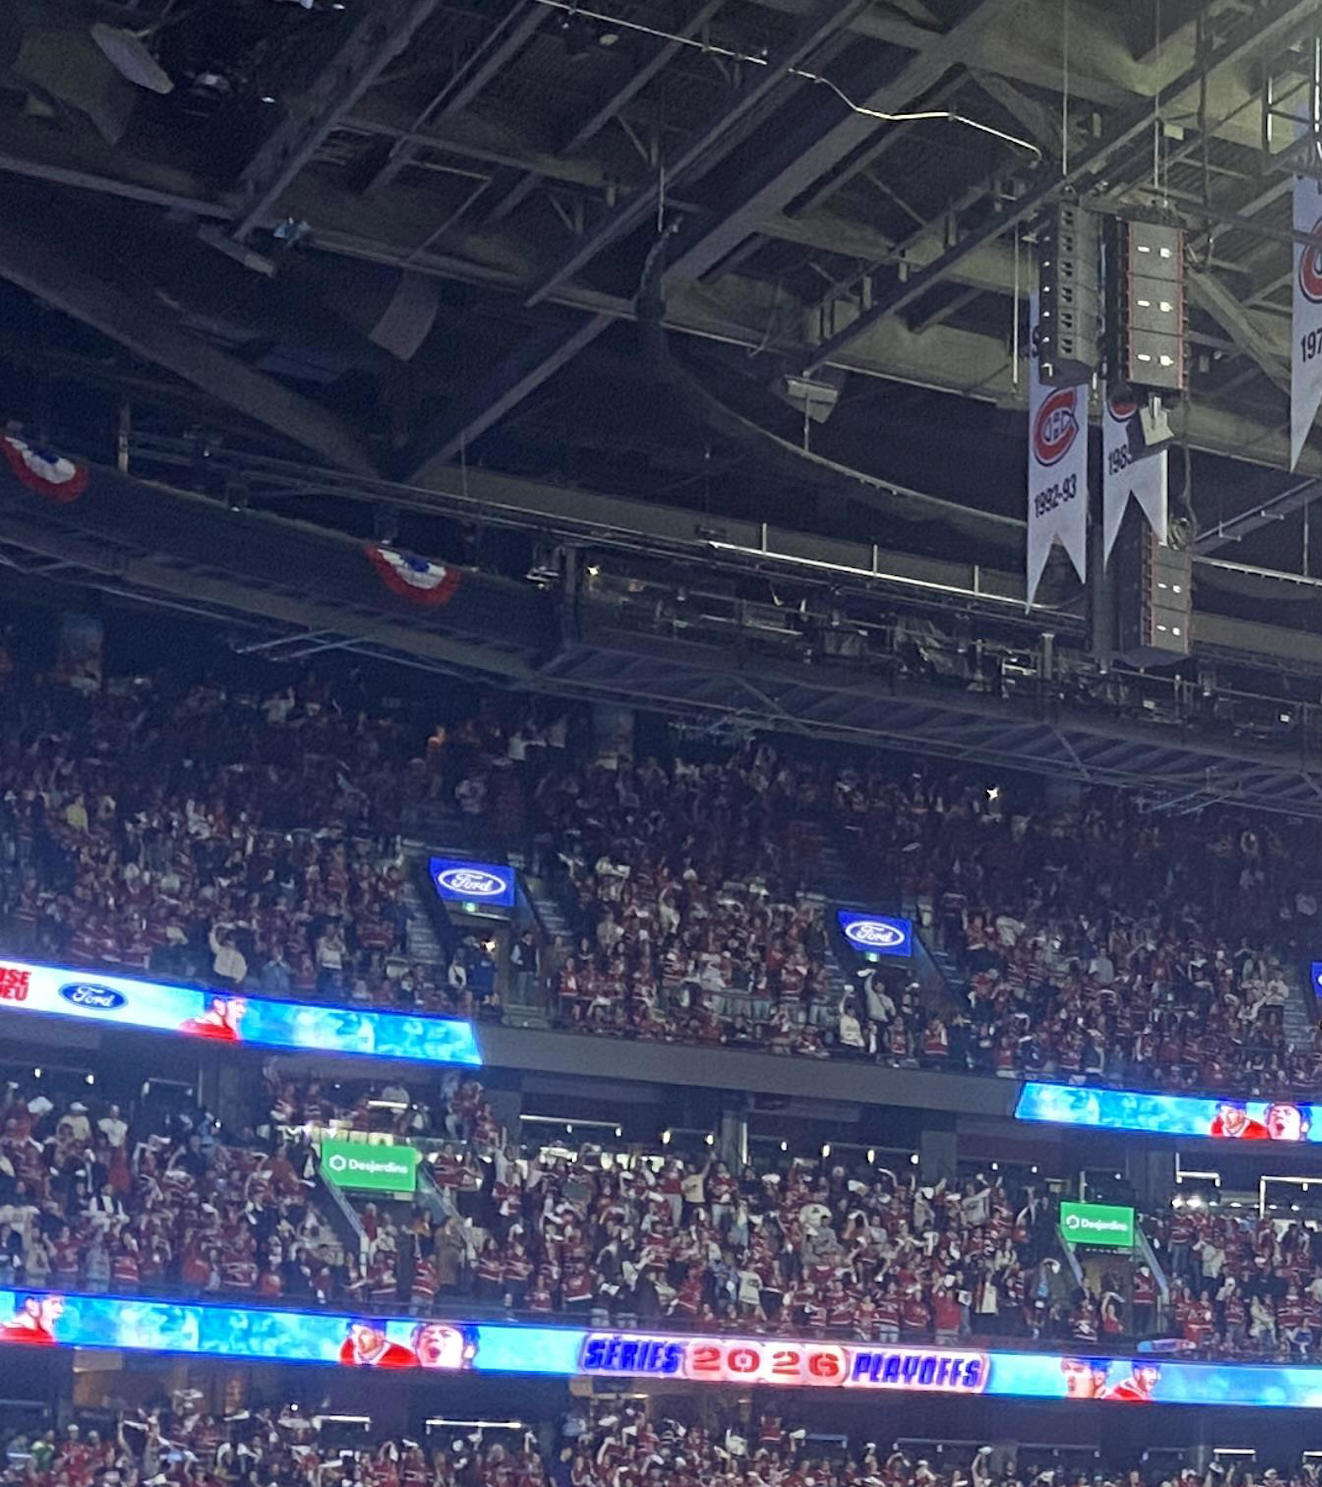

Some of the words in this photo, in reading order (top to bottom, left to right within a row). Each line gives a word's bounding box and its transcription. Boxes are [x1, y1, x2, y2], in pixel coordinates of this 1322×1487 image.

[448, 870, 499, 895] Ford
[72, 985, 117, 1008] Ford
[348, 1158, 409, 1175] Desjardins
[583, 1333, 684, 1374] SÉRIES
[691, 1346, 840, 1377] 2026
[851, 1352, 982, 1387] PLAYOFFS
